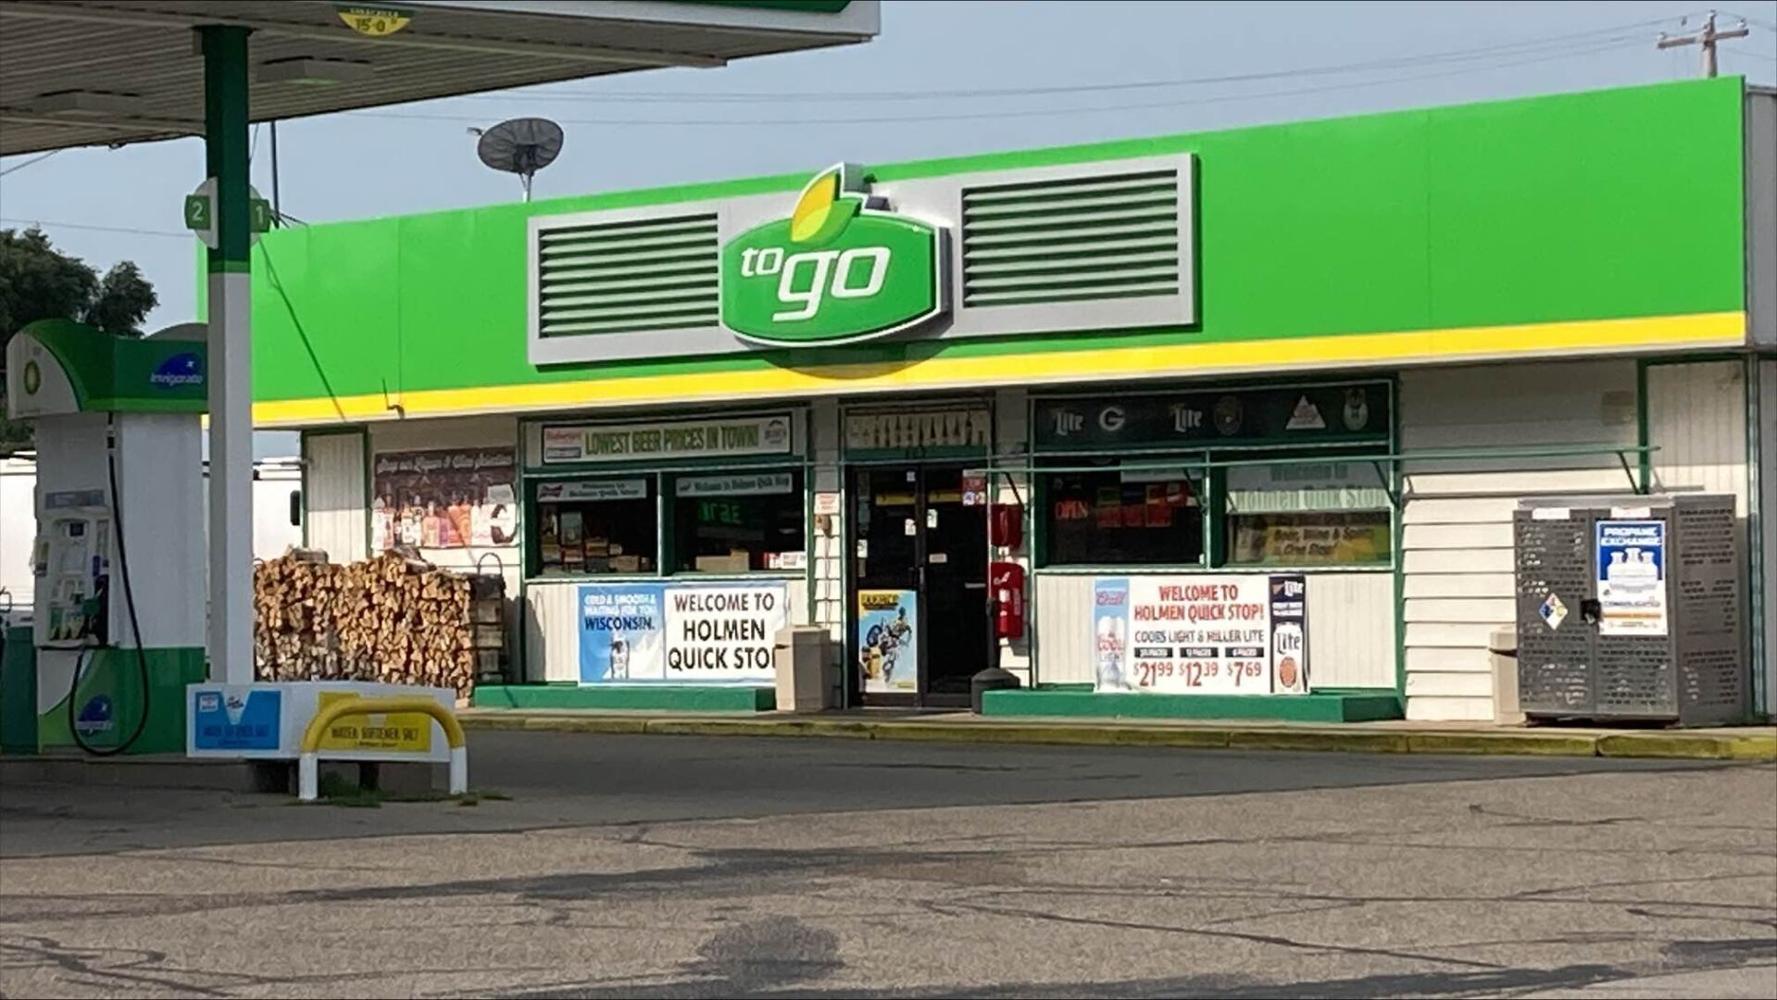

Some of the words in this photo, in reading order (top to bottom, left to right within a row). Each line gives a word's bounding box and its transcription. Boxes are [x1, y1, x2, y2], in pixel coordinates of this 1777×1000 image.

[192, 201, 203, 221] 2
[256, 205, 263, 224] 1
[741, 247, 784, 277] to
[772, 246, 891, 322] go
[1055, 411, 1083, 436] Lite
[1100, 407, 1125, 431] G
[1174, 408, 1202, 432] Lite
[585, 431, 630, 455] LOWEST
[633, 430, 662, 452] BEER
[664, 427, 704, 450] PRICES
[707, 426, 718, 448] IN
[1055, 500, 1089, 520] OPEN
[674, 593, 749, 612] WELCOME
[754, 592, 775, 611] TO
[1158, 585, 1218, 601] WELCOME
[1221, 584, 1239, 600] TO
[584, 616, 656, 631] WISCONSIN.
[1134, 604, 1185, 621] HOLMEN
[1188, 604, 1225, 624] QUICK
[1228, 603, 1264, 620] STOP!
[683, 619, 765, 641] HOLMEN
[1134, 630, 1166, 643] COORS
[1168, 630, 1195, 643] LIGHT
[1207, 629, 1242, 643] MILLER
[1244, 629, 1264, 642] LITE
[1276, 632, 1301, 655] Lite
[668, 646, 728, 672] QUICK
